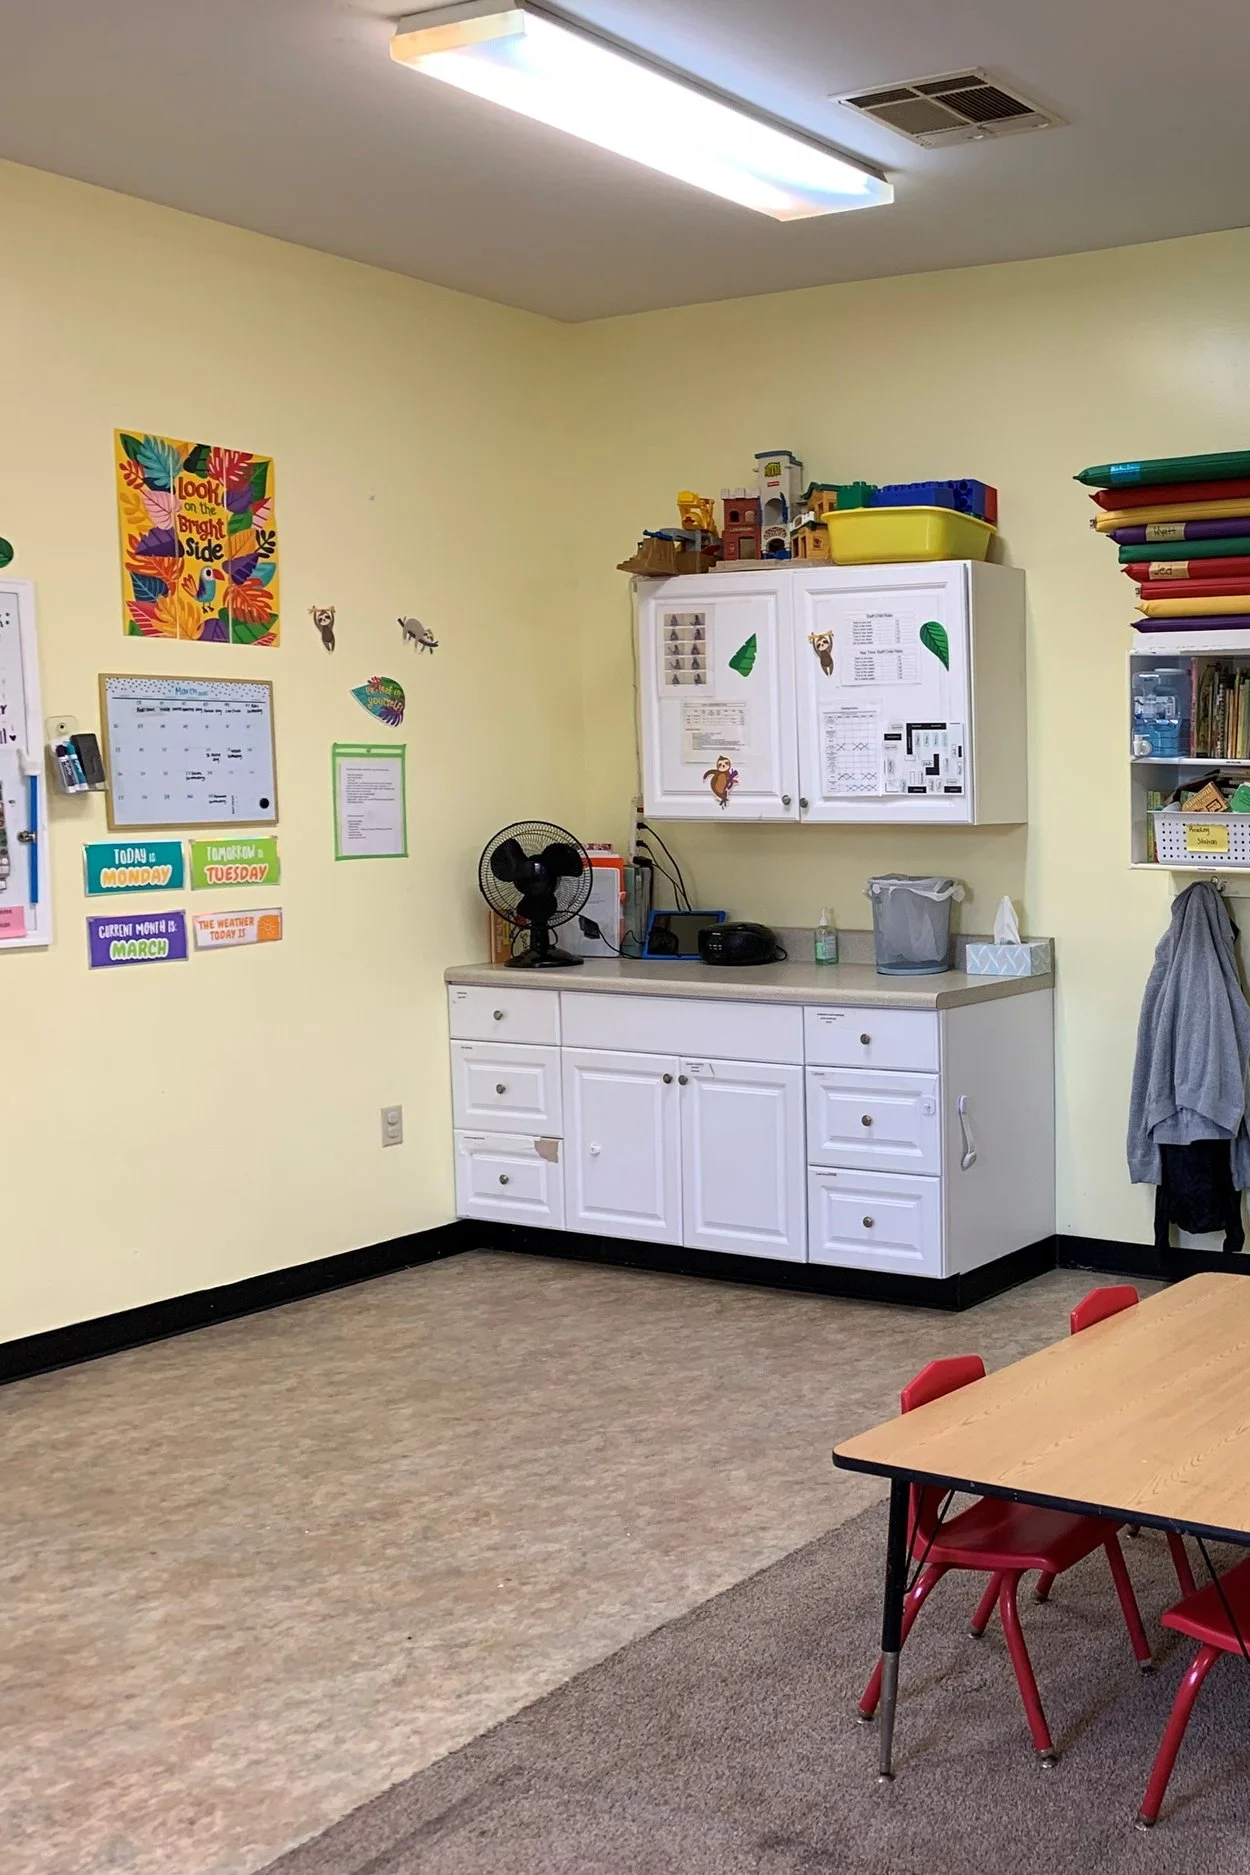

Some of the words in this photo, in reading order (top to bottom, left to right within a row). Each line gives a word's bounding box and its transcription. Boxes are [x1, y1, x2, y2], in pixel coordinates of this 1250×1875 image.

[178, 476, 221, 507] Look
[184, 502, 198, 514] on
[199, 501, 217, 516] the
[177, 514, 227, 542] Bright
[185, 536, 225, 563] Side
[1154, 565, 1173, 576] Jed
[114, 847, 147, 865] TODAY
[148, 852, 156, 863] IS
[206, 845, 256, 862] TOMORROW
[101, 865, 172, 889] MONDAY
[205, 864, 269, 885] TUESDAY
[98, 923, 133, 939] CURRENT
[135, 920, 166, 936] MONTH
[199, 919, 215, 931] THE
[216, 916, 254, 929] WEATHER
[209, 930, 236, 942] TODAY
[237, 928, 247, 939] IS
[110, 938, 169, 961] MARCH
